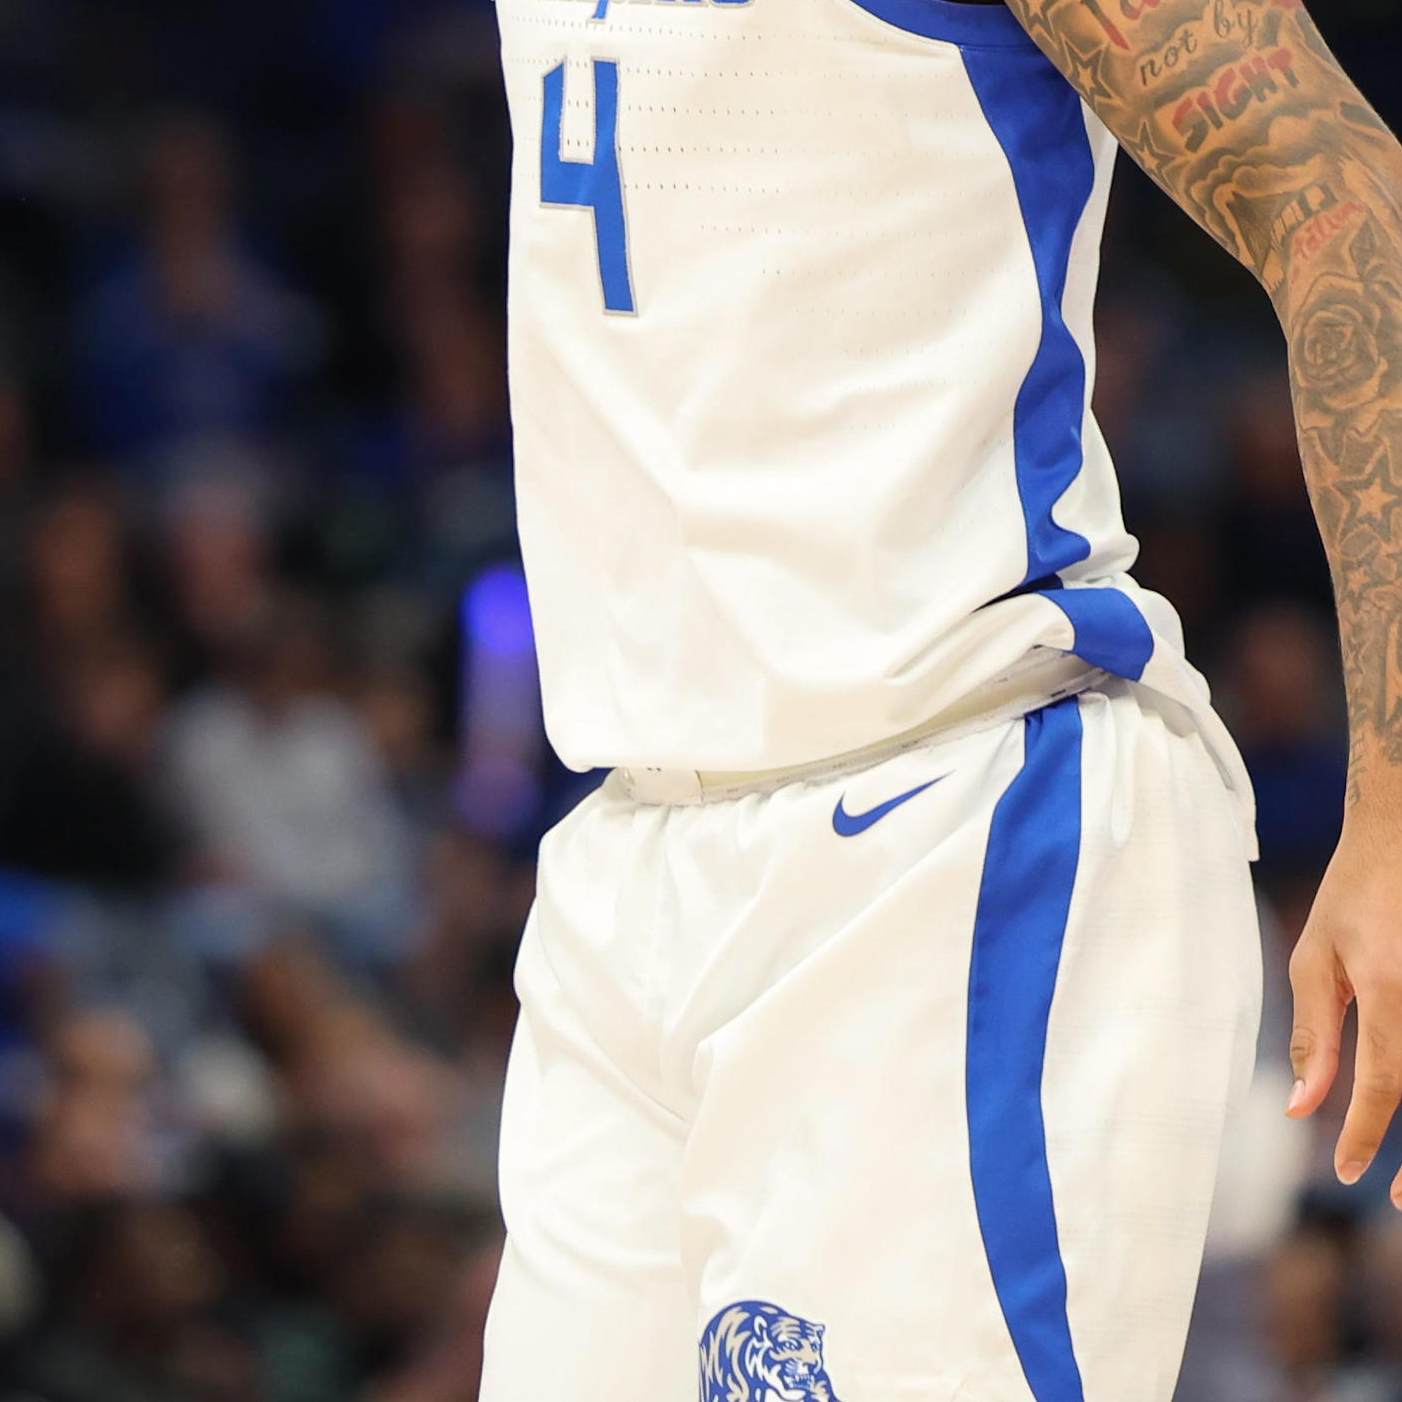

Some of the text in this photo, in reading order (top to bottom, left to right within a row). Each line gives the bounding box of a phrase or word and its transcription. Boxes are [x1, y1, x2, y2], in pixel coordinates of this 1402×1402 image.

[1140, 29, 1197, 86] not
[1171, 48, 1300, 152] SIGHT
[539, 55, 639, 318] 4
